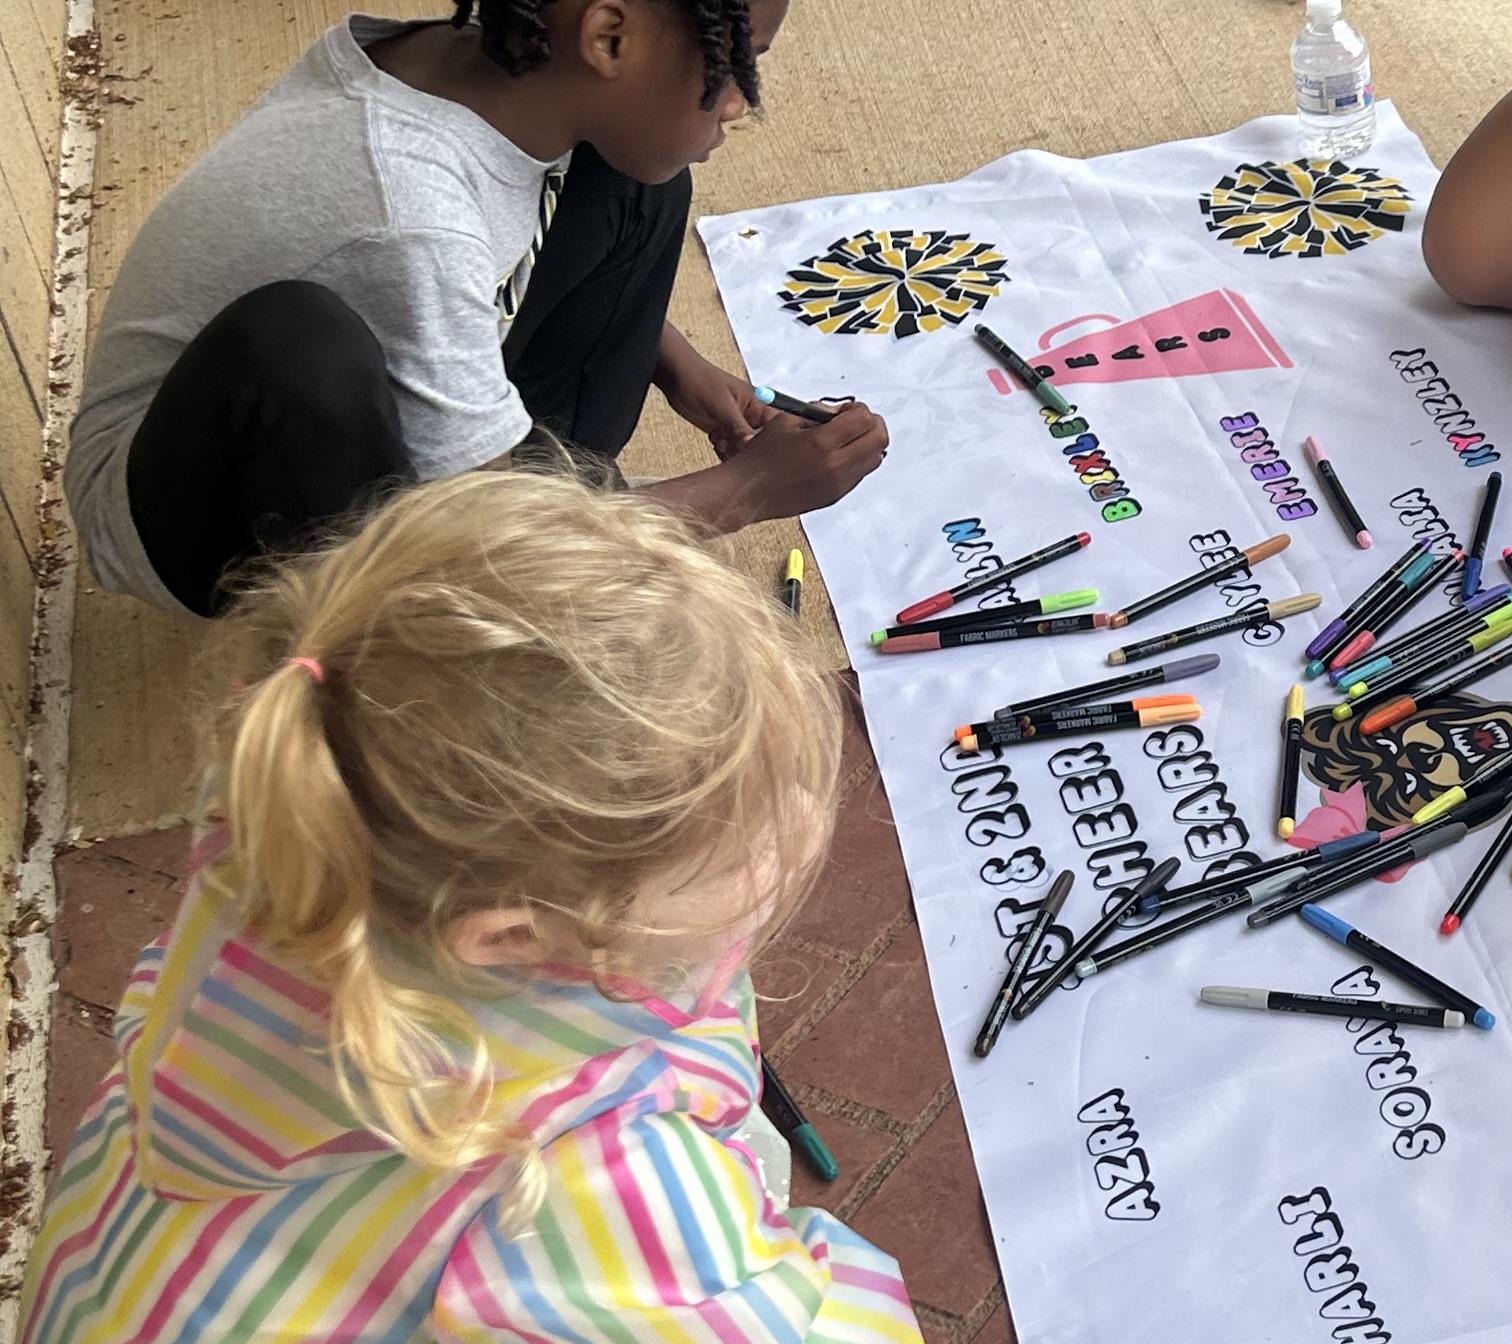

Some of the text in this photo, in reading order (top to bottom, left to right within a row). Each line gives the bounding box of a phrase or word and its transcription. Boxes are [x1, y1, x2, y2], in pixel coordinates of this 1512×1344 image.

[1038, 404, 1143, 523] BRIXLEY
[1388, 347, 1502, 468] KYNZLEY
[1219, 411, 1318, 522] EMERIE
[980, 844, 1045, 886] &
[994, 896, 1081, 991] ST
[1077, 1088, 1161, 1221] AZRA
